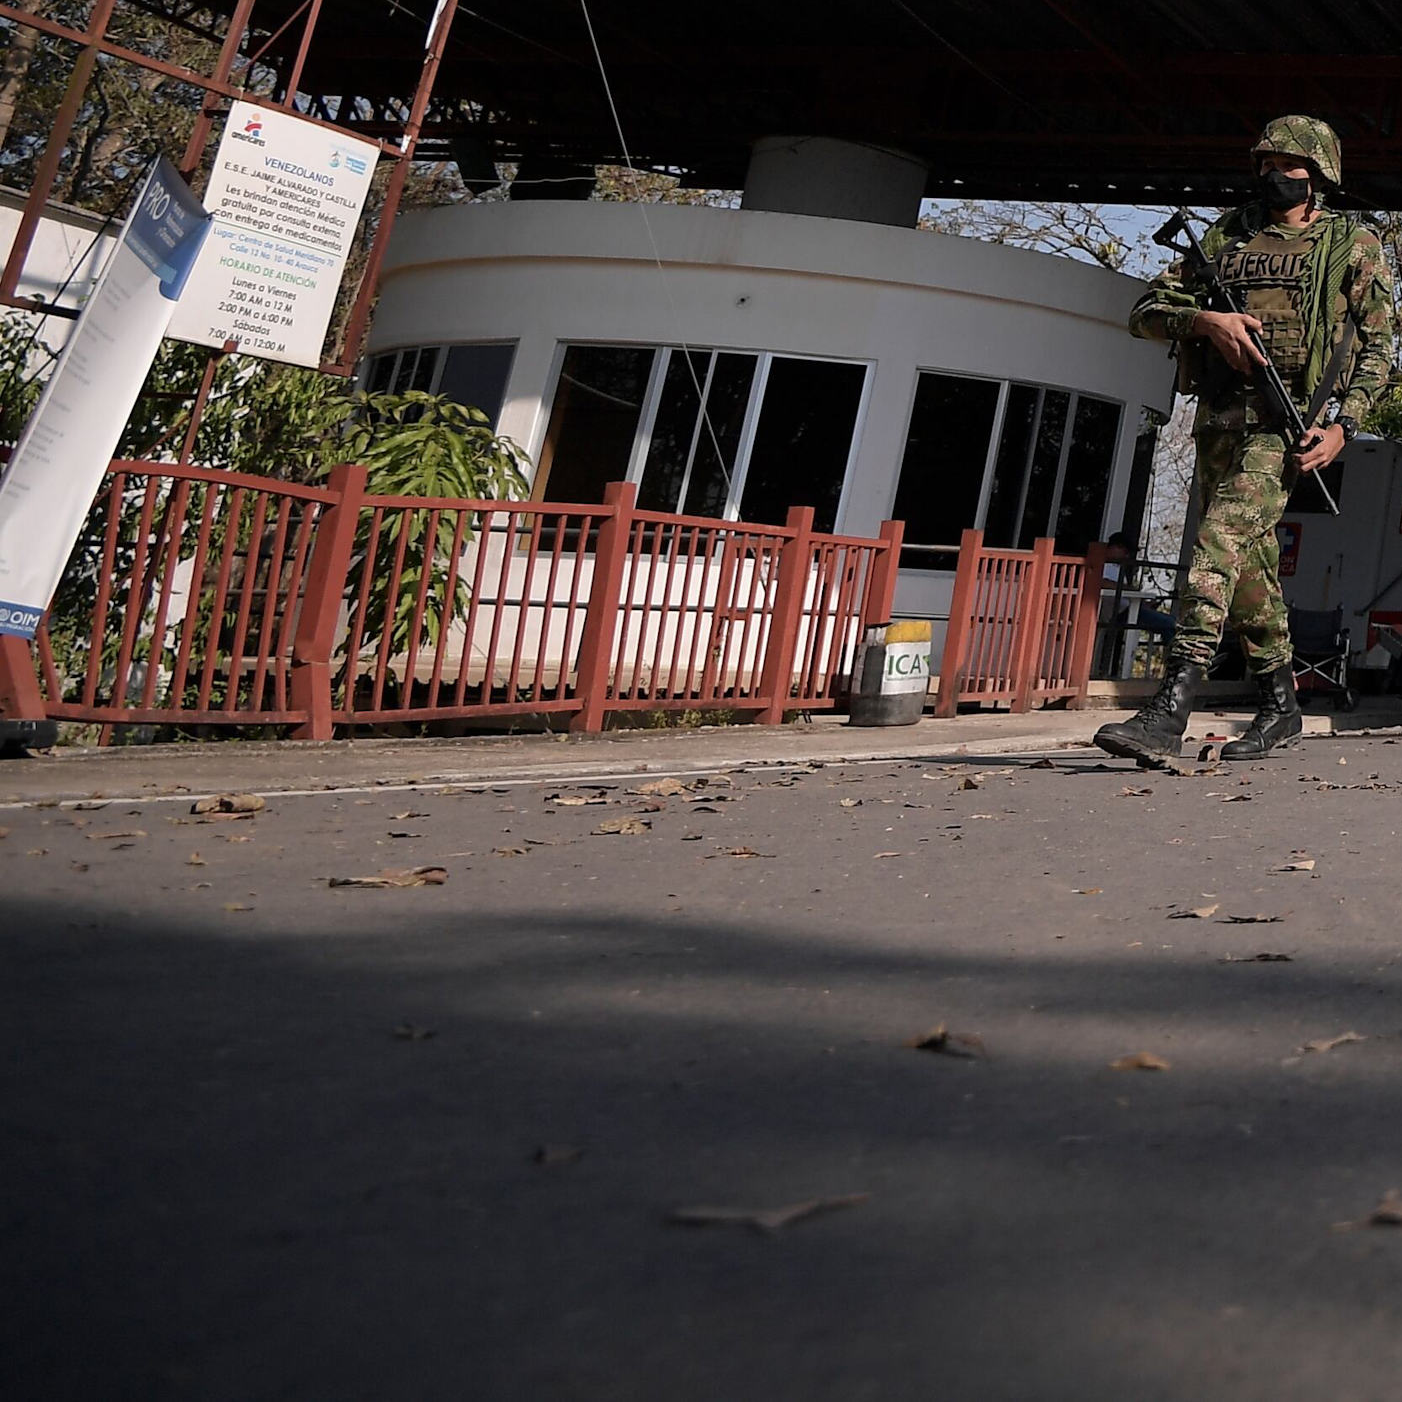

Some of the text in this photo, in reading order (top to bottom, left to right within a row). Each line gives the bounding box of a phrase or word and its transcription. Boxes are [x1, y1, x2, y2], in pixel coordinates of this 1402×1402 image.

[264, 156, 334, 186] VENEZOLANOS
[223, 161, 356, 209] E.S.E. JAIME ALVARADO Y CASTILLA
[265, 184, 320, 208] Y AMERICARES
[142, 181, 171, 220] PRO
[220, 197, 257, 213] gratuita
[258, 208, 275, 217] por
[275, 213, 311, 229] consulta
[225, 184, 345, 227] Les brindan atención Médica
[213, 208, 342, 251] con entrega de medicamentos
[238, 233, 262, 246] Centro
[263, 241, 273, 249] de
[274, 243, 294, 255] Salud
[228, 242, 248, 253] Calle
[294, 260, 318, 273] Arauca
[1223, 253, 1305, 278] EJERCIT
[219, 255, 317, 288] HORARIO DE ATENCIÓN
[228, 289, 247, 301] 7:00
[247, 294, 263, 305] AM
[273, 300, 283, 310] 12
[283, 303, 292, 312] M
[231, 276, 256, 290] Lunes
[267, 284, 296, 300] Viernes
[217, 301, 293, 326] 2:00 PM a 6:00 PM
[232, 318, 270, 335] Sábados
[207, 327, 285, 352] 7:00 AM a 12:00 M
[10, 611, 40, 627] OIM
[888, 654, 921, 675] ICA
